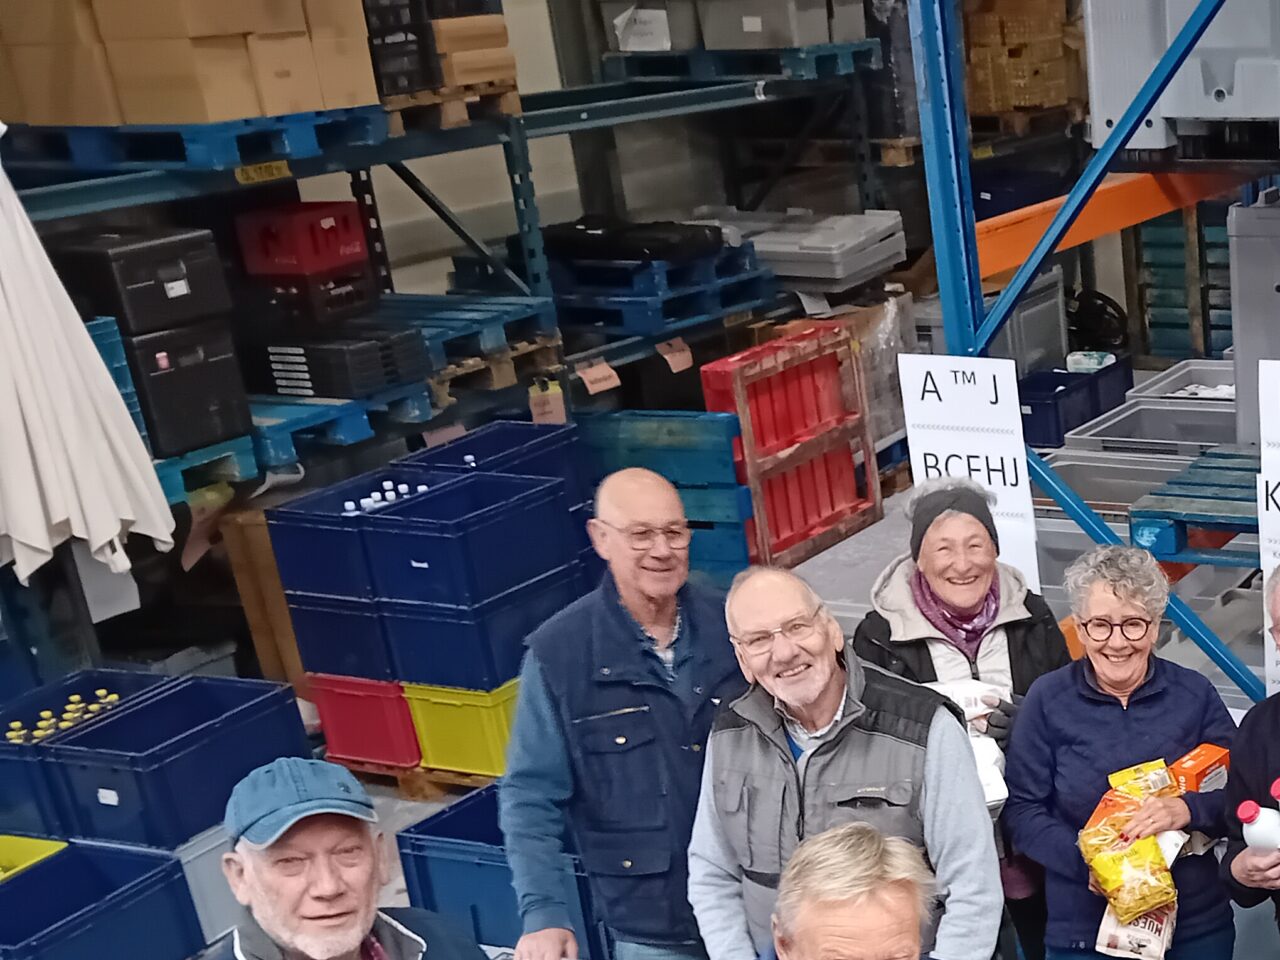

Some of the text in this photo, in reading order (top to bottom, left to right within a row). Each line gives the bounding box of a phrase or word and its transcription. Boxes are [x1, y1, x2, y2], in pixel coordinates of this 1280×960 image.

[920, 370, 943, 402] A
[988, 374, 999, 405] J
[1129, 917, 1163, 937] MUES
